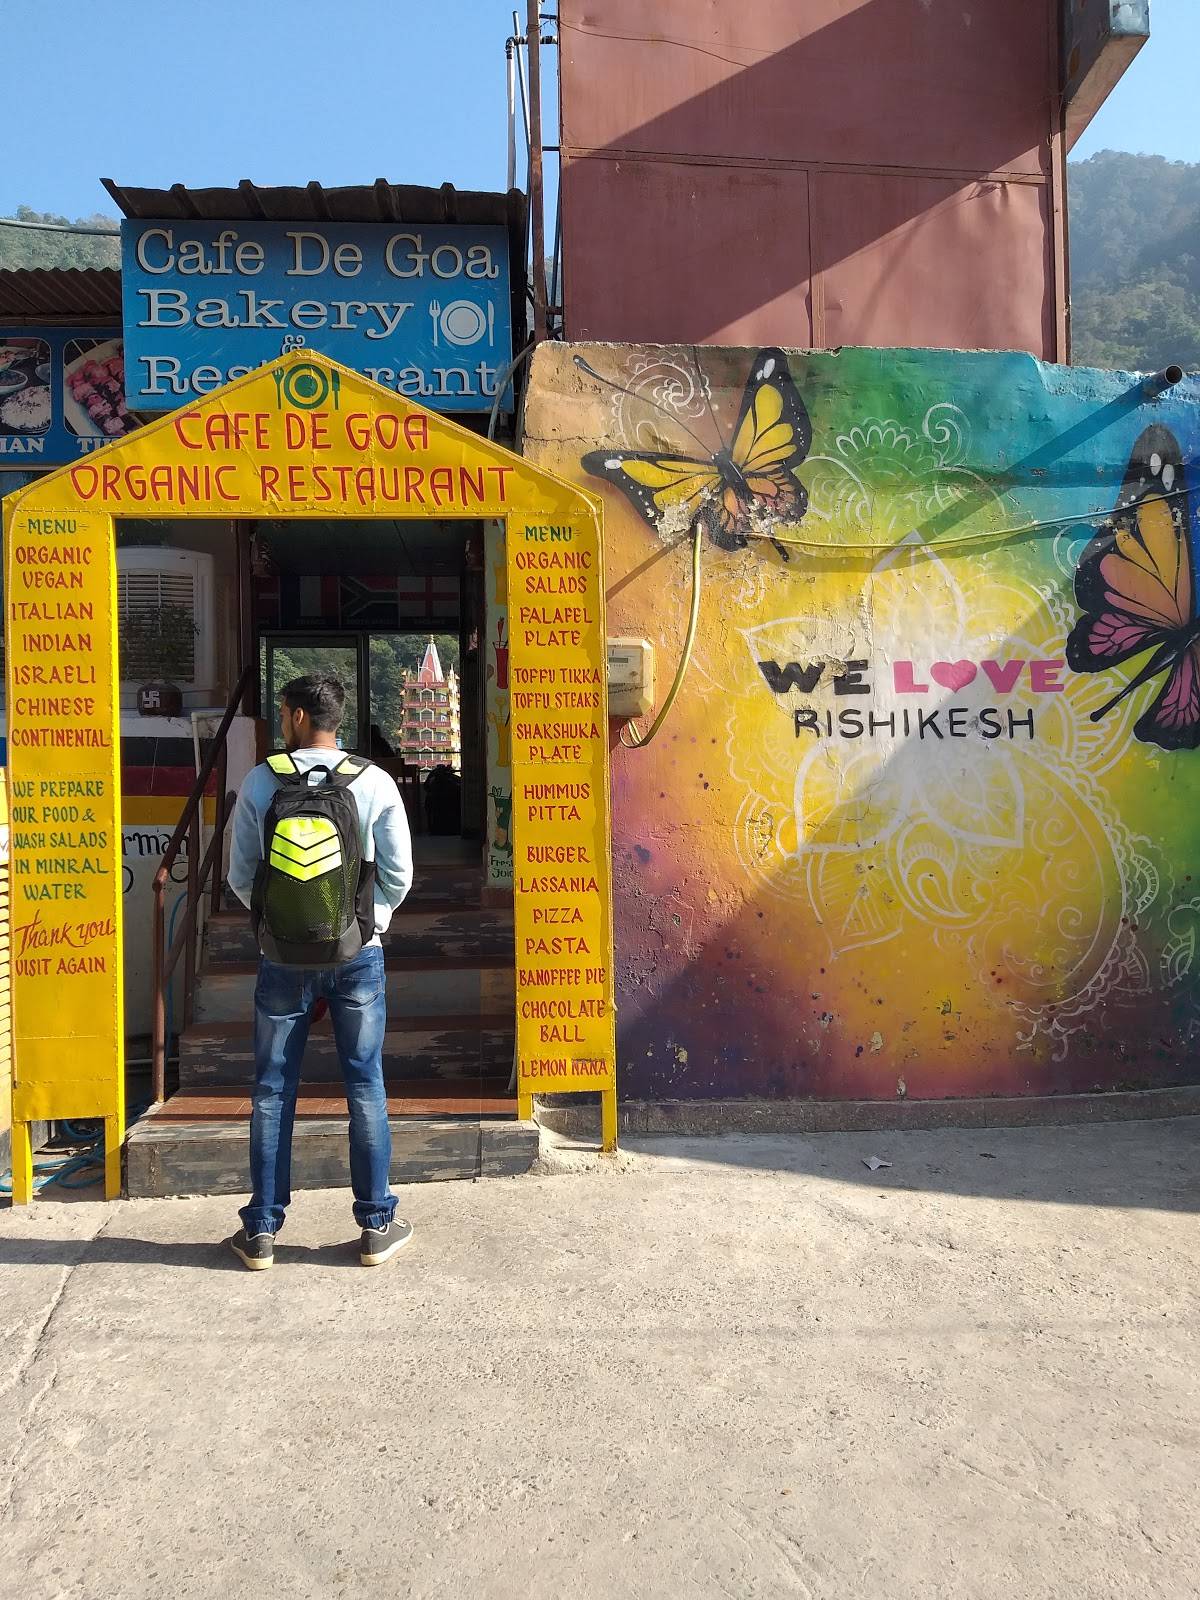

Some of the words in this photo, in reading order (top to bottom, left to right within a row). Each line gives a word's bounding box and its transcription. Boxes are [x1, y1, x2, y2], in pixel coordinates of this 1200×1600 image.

[137, 228, 265, 275] Cafe
[286, 231, 363, 277] De
[385, 233, 499, 279] Goa
[138, 288, 415, 339] Bakery
[174, 412, 271, 451] CAFE
[285, 412, 332, 450] DE
[345, 412, 429, 451] GOA
[70, 464, 240, 505] ORGANIC
[261, 465, 514, 506] RESTAURANT
[27, 518, 77, 535] MENU
[525, 525, 572, 542] MENU
[15, 545, 92, 565] ORGANIC
[515, 551, 592, 570] ORGANIC
[22, 571, 83, 589] VEGAN
[525, 575, 588, 594] SALADS
[11, 601, 94, 621] ITALIAN
[520, 606, 593, 624] FALAFEL
[23, 633, 92, 652] INDIAN
[525, 630, 581, 646] PLATE
[14, 664, 96, 685] ISRAELI
[514, 667, 555, 684] TOFFU
[560, 667, 601, 684] TIKKA
[757, 658, 871, 696] WE
[15, 697, 95, 716] CHINESE
[513, 692, 550, 709] TOFFU
[555, 691, 600, 709] STEAKS
[516, 722, 600, 740] SHAKSHUKA
[794, 707, 1035, 740] RISHIKESH
[11, 728, 110, 747] CONTINENTAL
[529, 745, 582, 760] PLATE
[13, 781, 35, 797] WE
[40, 781, 104, 797] PREPARE
[524, 783, 591, 800] HUMMUS
[12, 806, 38, 823] OUR
[43, 806, 79, 823] FOOD
[82, 808, 96, 822] &
[528, 805, 581, 821] PITTA
[14, 832, 46, 849] WASH
[50, 832, 107, 849] SALADS
[527, 845, 591, 863] BURGER
[15, 858, 31, 874] IN
[36, 858, 109, 874] MINRAL
[23, 883, 87, 901] WATER
[519, 876, 600, 893] LASSANIA
[532, 907, 584, 924] PIZZA
[14, 908, 85, 958] Thank
[525, 937, 591, 954] PASTA
[15, 958, 52, 977] VISIT
[56, 956, 106, 975] AGAIN
[519, 967, 581, 986] BANOFFEE
[586, 967, 606, 985] PIE
[522, 999, 606, 1019] CHOCOLATE
[540, 1024, 586, 1042] BALL
[521, 1058, 567, 1078] LEMON
[571, 1058, 608, 1076] NANA
